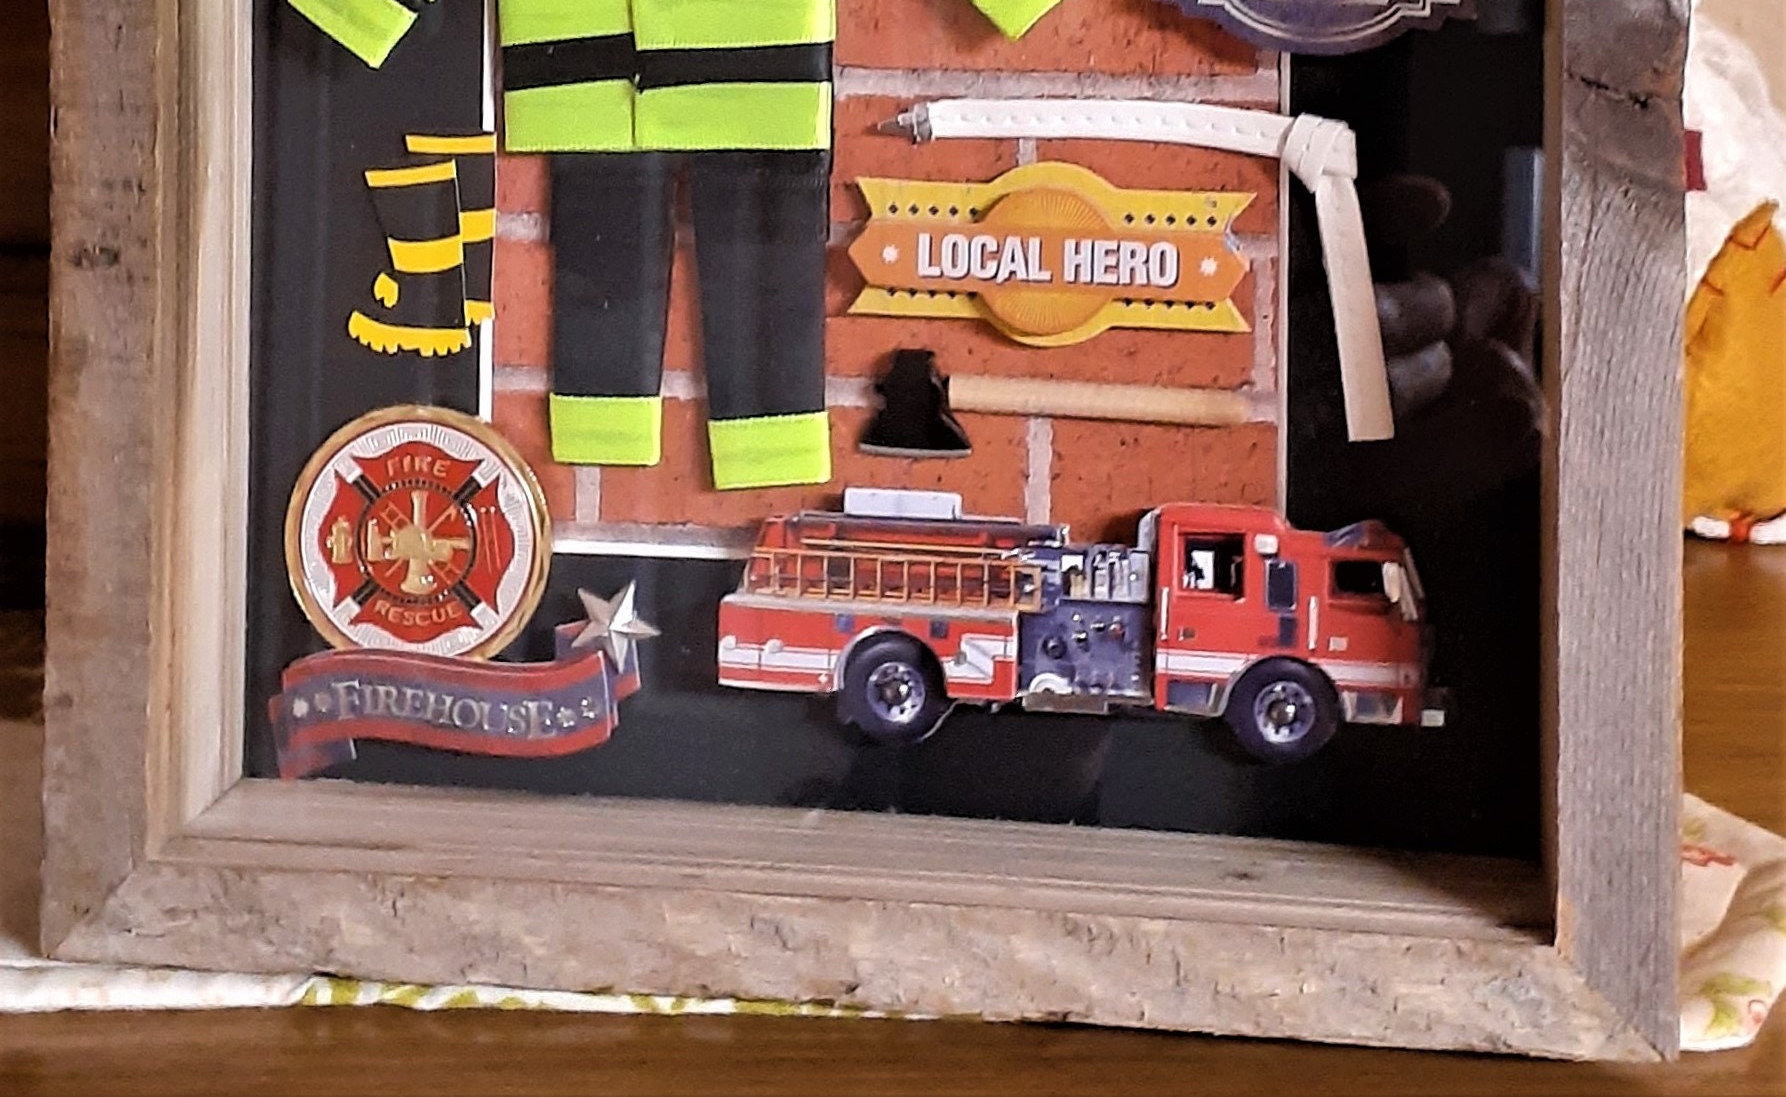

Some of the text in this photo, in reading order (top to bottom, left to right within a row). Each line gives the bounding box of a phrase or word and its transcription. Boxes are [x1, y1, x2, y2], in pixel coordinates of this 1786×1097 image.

[916, 232, 1181, 287] LOCAL HERO
[385, 454, 452, 479] FIRE
[374, 599, 463, 627] RESCUE
[331, 678, 554, 740] FIREHOUSE
